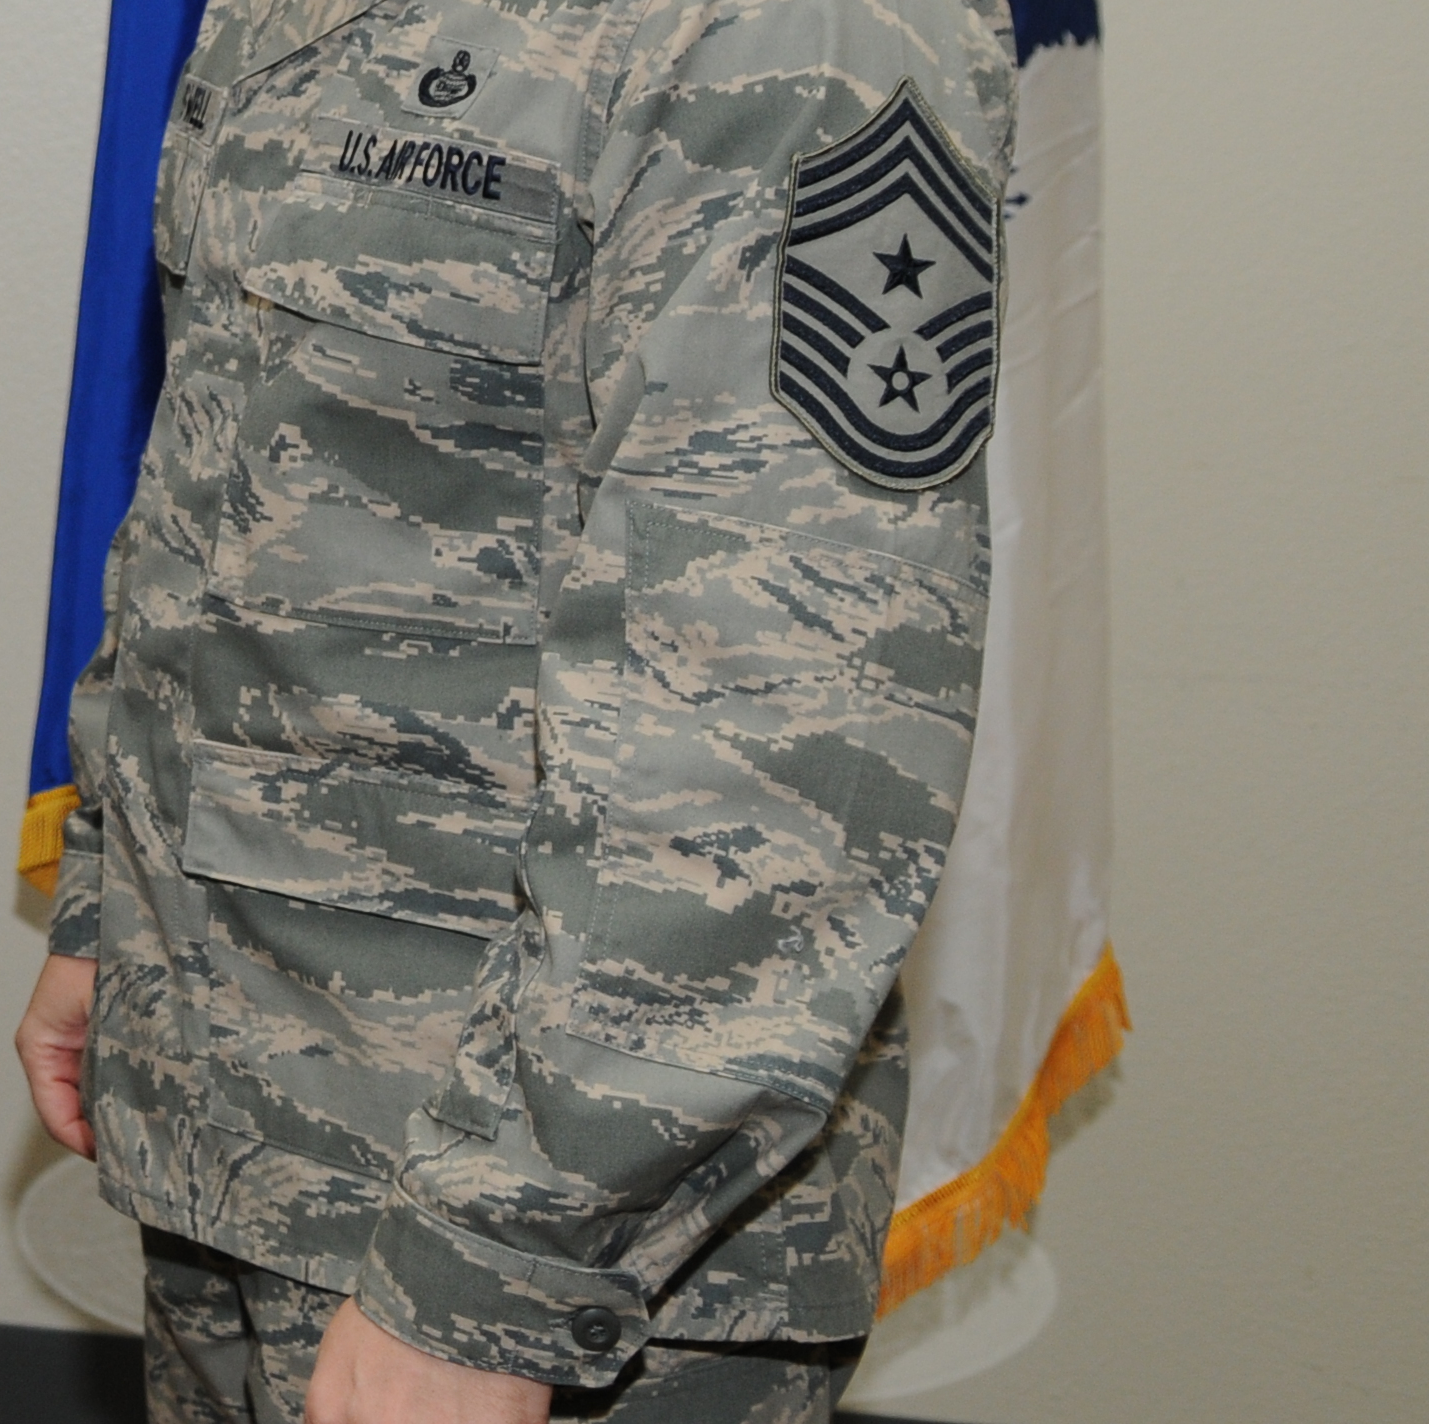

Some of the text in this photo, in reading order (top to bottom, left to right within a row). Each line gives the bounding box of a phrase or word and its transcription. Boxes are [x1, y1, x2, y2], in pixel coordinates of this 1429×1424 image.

[338, 130, 507, 201] U.S. AIR FORCE
